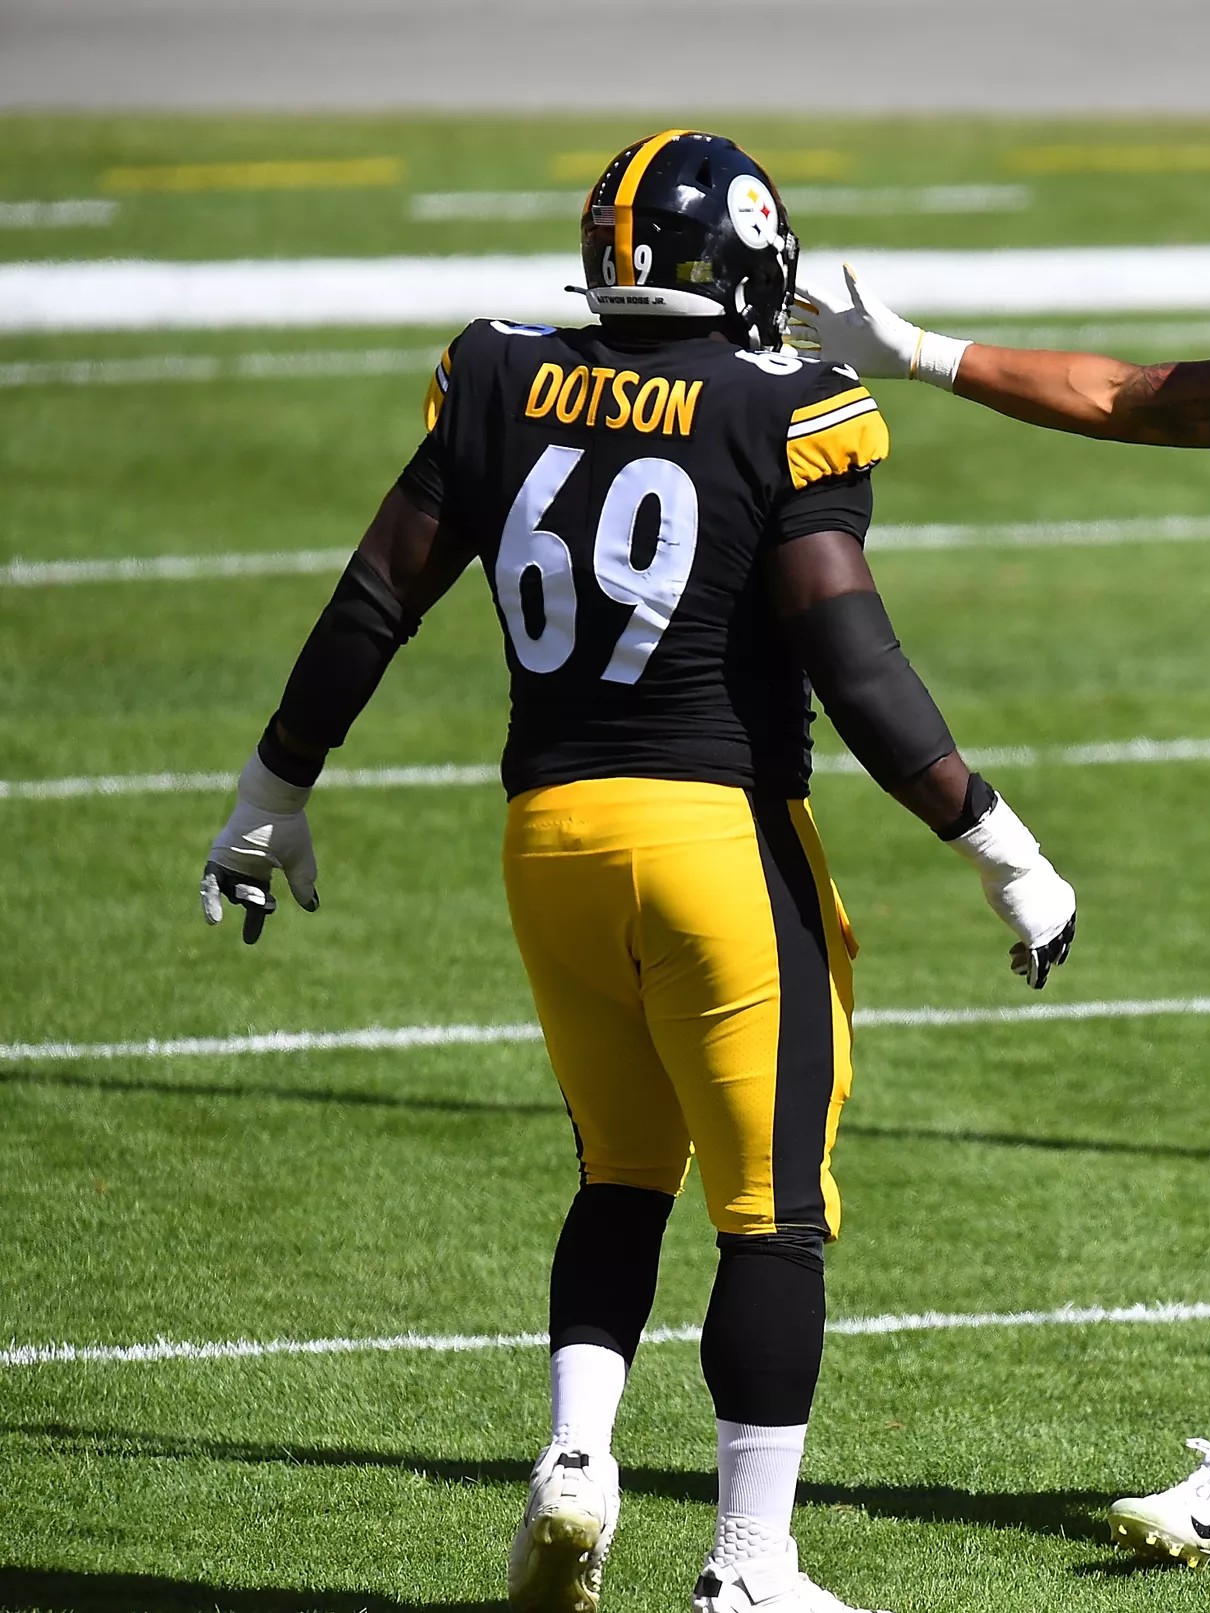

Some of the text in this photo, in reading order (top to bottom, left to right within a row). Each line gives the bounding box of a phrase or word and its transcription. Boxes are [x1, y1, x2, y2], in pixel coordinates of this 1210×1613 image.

[602, 244, 653, 286] 69
[524, 361, 704, 437] DOTSON
[494, 443, 699, 686] 69
